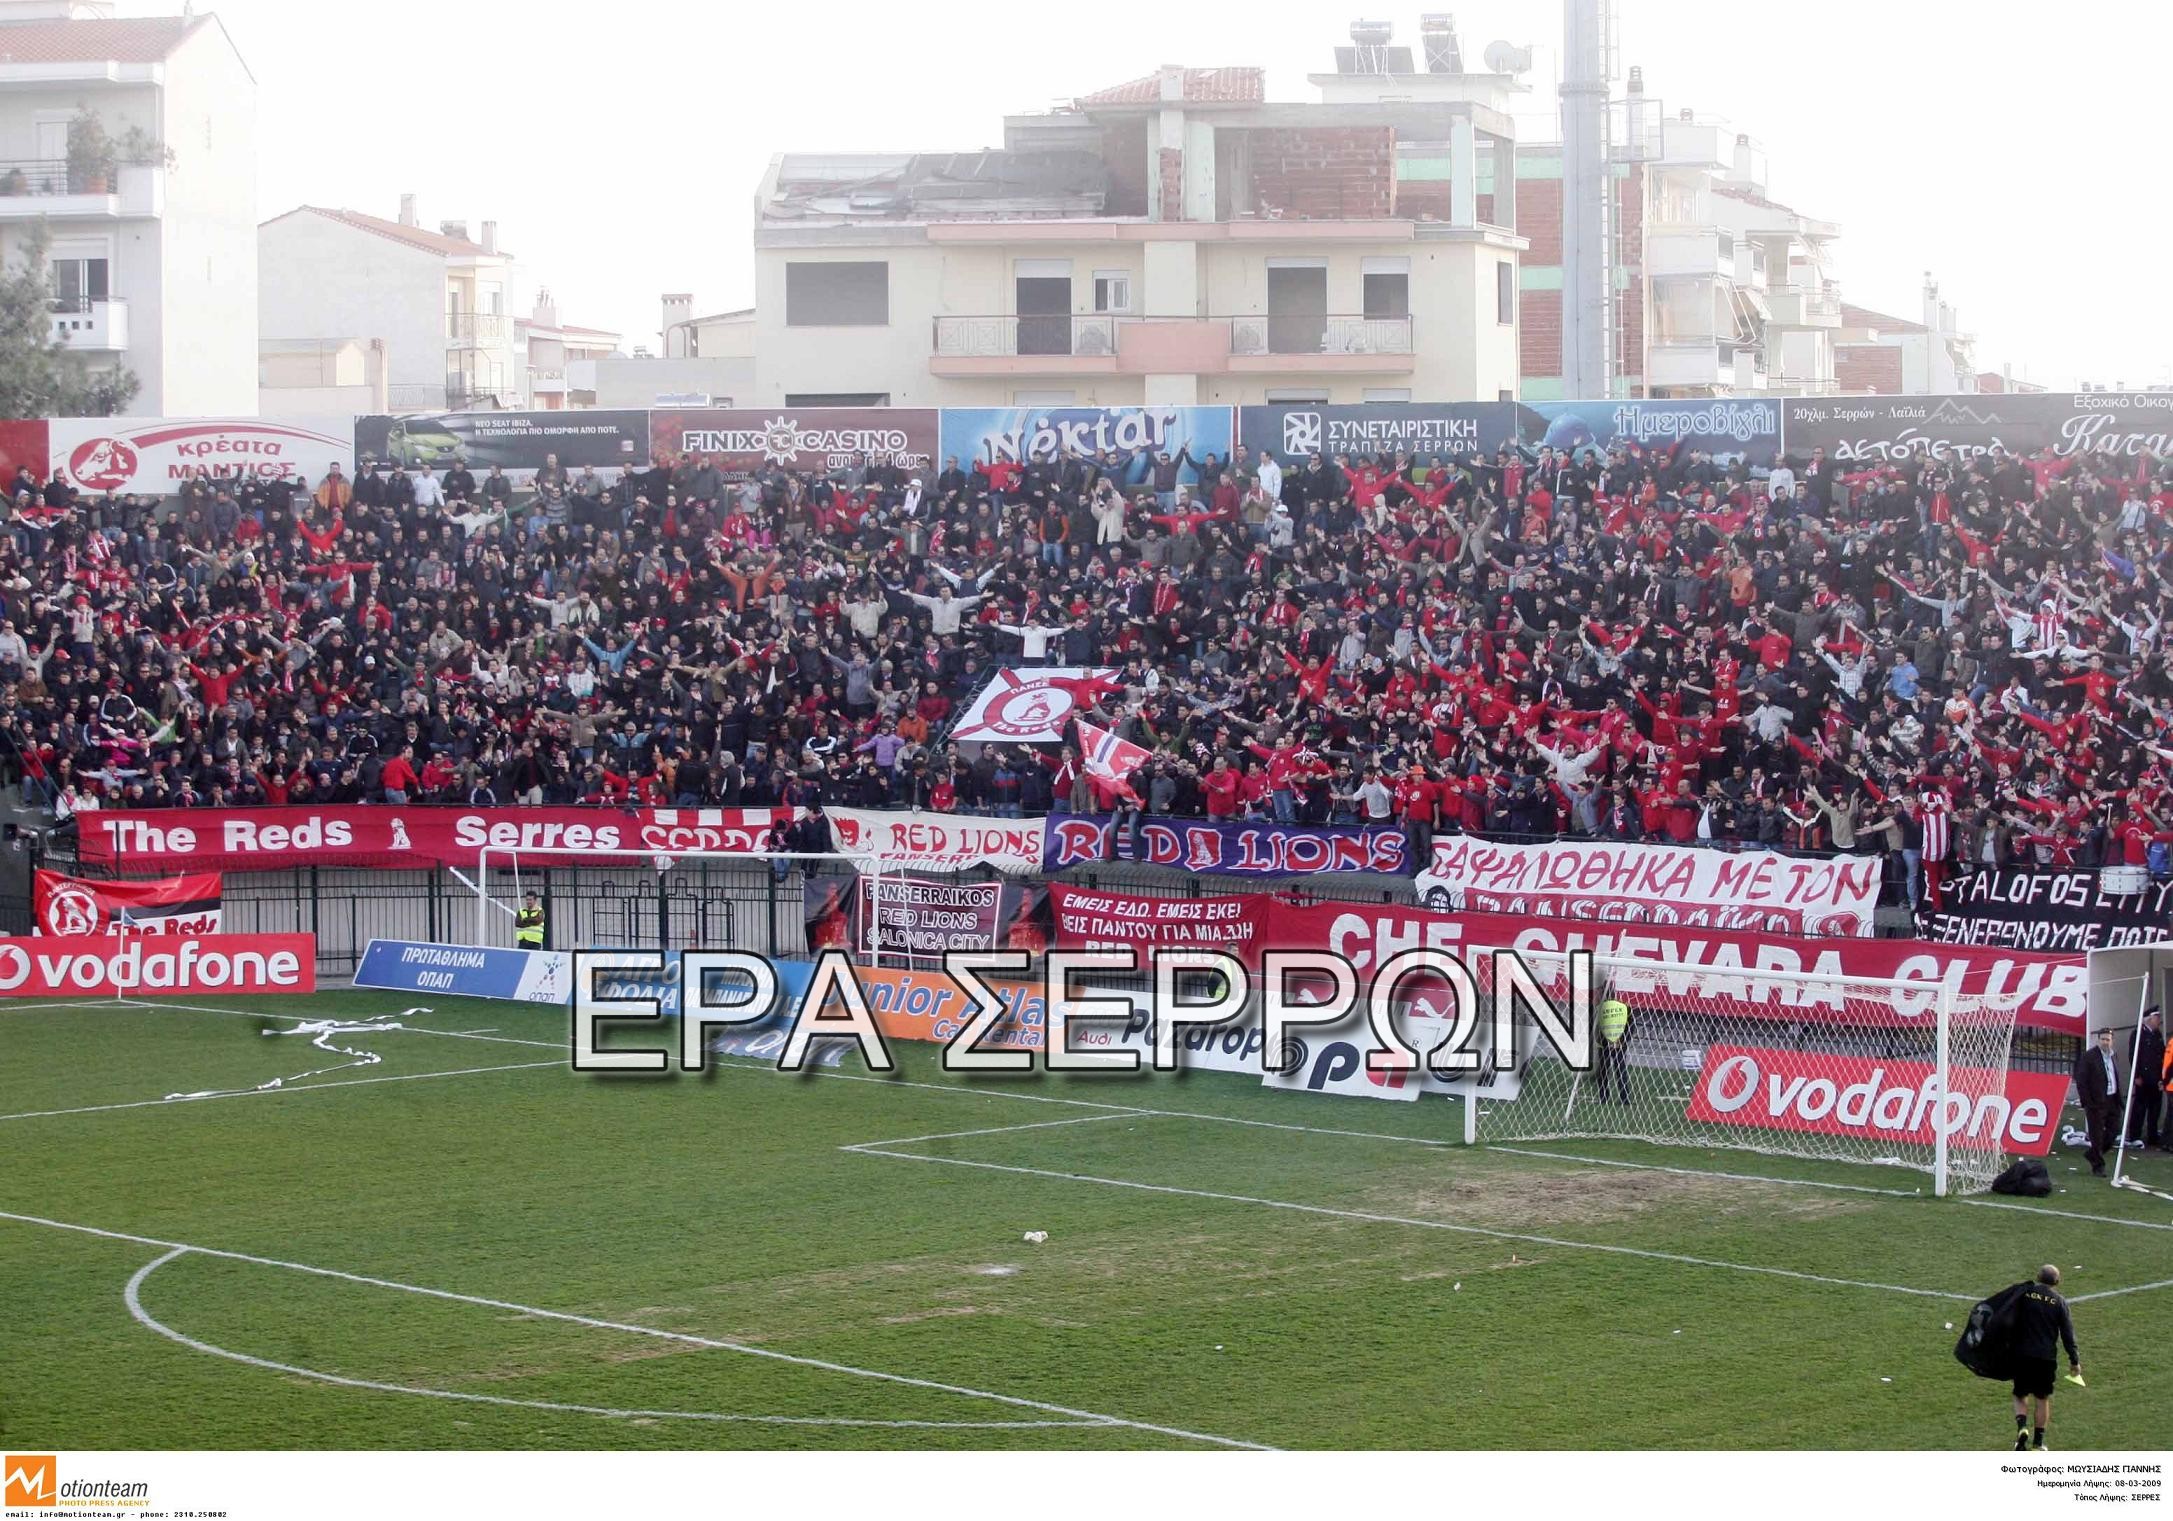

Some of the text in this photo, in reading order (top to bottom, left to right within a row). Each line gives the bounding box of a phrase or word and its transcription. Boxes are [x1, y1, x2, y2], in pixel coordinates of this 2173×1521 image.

[1834, 406, 1875, 422] Σερρών
[2074, 395, 2130, 411] Εξοχικό
[1328, 419, 1477, 439] ΣΥΝΕΤΑΙΡΙΣΤΙΚΗ
[1614, 404, 1776, 442] Ημεροβίγλι
[683, 430, 762, 452] FINIX
[799, 430, 907, 452] CASINO
[103, 816, 620, 852] The Reds Serres
[891, 824, 1040, 855] RED LIONS
[1236, 830, 1403, 873] LIONS
[1709, 855, 1774, 899] ΜΕ
[1784, 862, 1875, 905] ΤΟΝ
[865, 882, 994, 907] PANSERRAIKOS
[880, 907, 978, 929] RED LIONS
[1063, 894, 1113, 913] ΕΜΕΙΣ
[1156, 904, 1203, 919] ΕΜΕΙΣ
[165, 915, 217, 934] Reds
[1092, 918, 1156, 939] ΠΑΝΤΟΥ
[1163, 924, 1191, 940] ΓΙΑ
[1196, 924, 1221, 941] ΜΙΑ
[867, 928, 989, 951] SALONICA CITY
[38, 941, 299, 988] vodafone
[402, 947, 485, 969] ΠΡΩΤΑΘΛΗΜΑ
[417, 970, 454, 988] ΟΠΑΠ
[1076, 1030, 1112, 1046] Audi
[1769, 1068, 2047, 1143] vodafone
